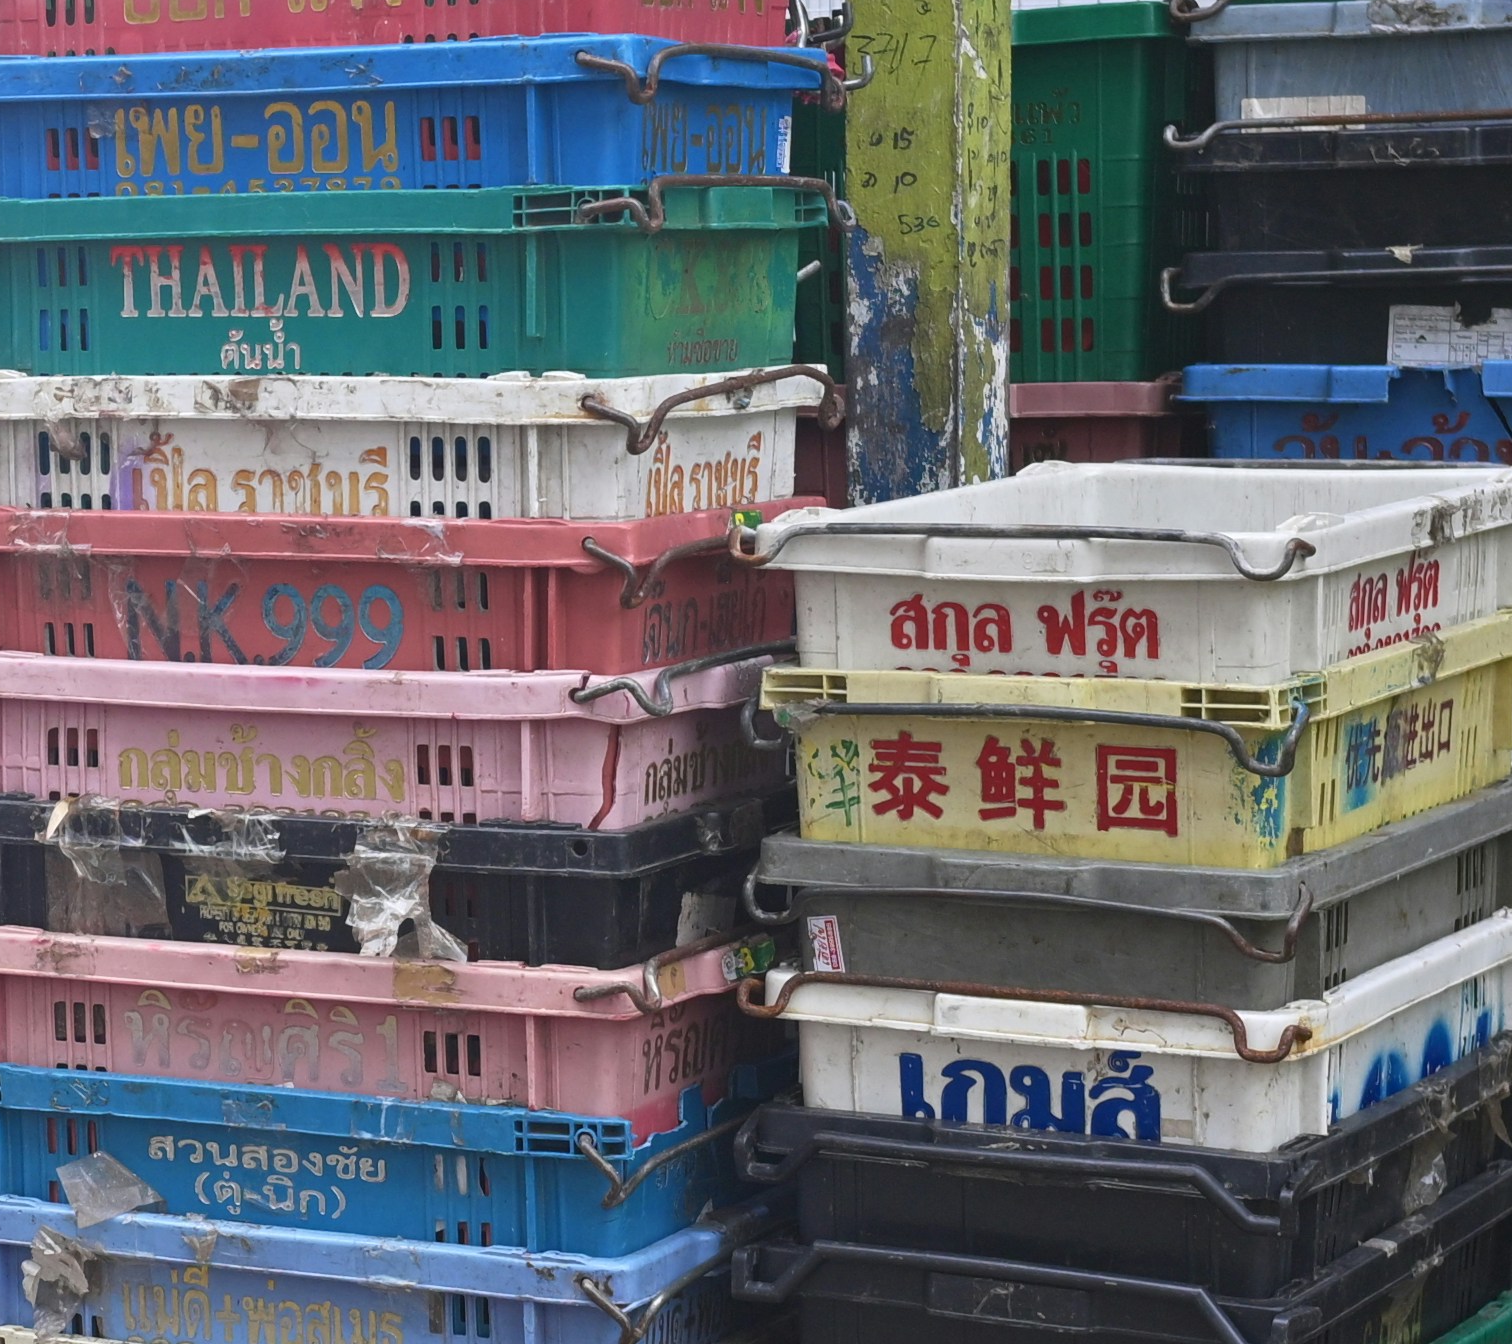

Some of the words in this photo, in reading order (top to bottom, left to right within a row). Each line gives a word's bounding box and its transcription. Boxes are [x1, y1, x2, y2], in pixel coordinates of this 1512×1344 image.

[115, 100, 399, 178] เพย-ออน
[109, 242, 412, 318] THAILAND
[220, 318, 302, 370] ต้นน้ำ
[890, 593, 1013, 666] สกุล
[118, 721, 406, 805] กลุ่มช้างกลิ้ง
[869, 731, 1179, 837] 泰鲜园
[898, 1052, 1162, 1143] เกมส์
[148, 1134, 387, 1183] สวนสองชัย
